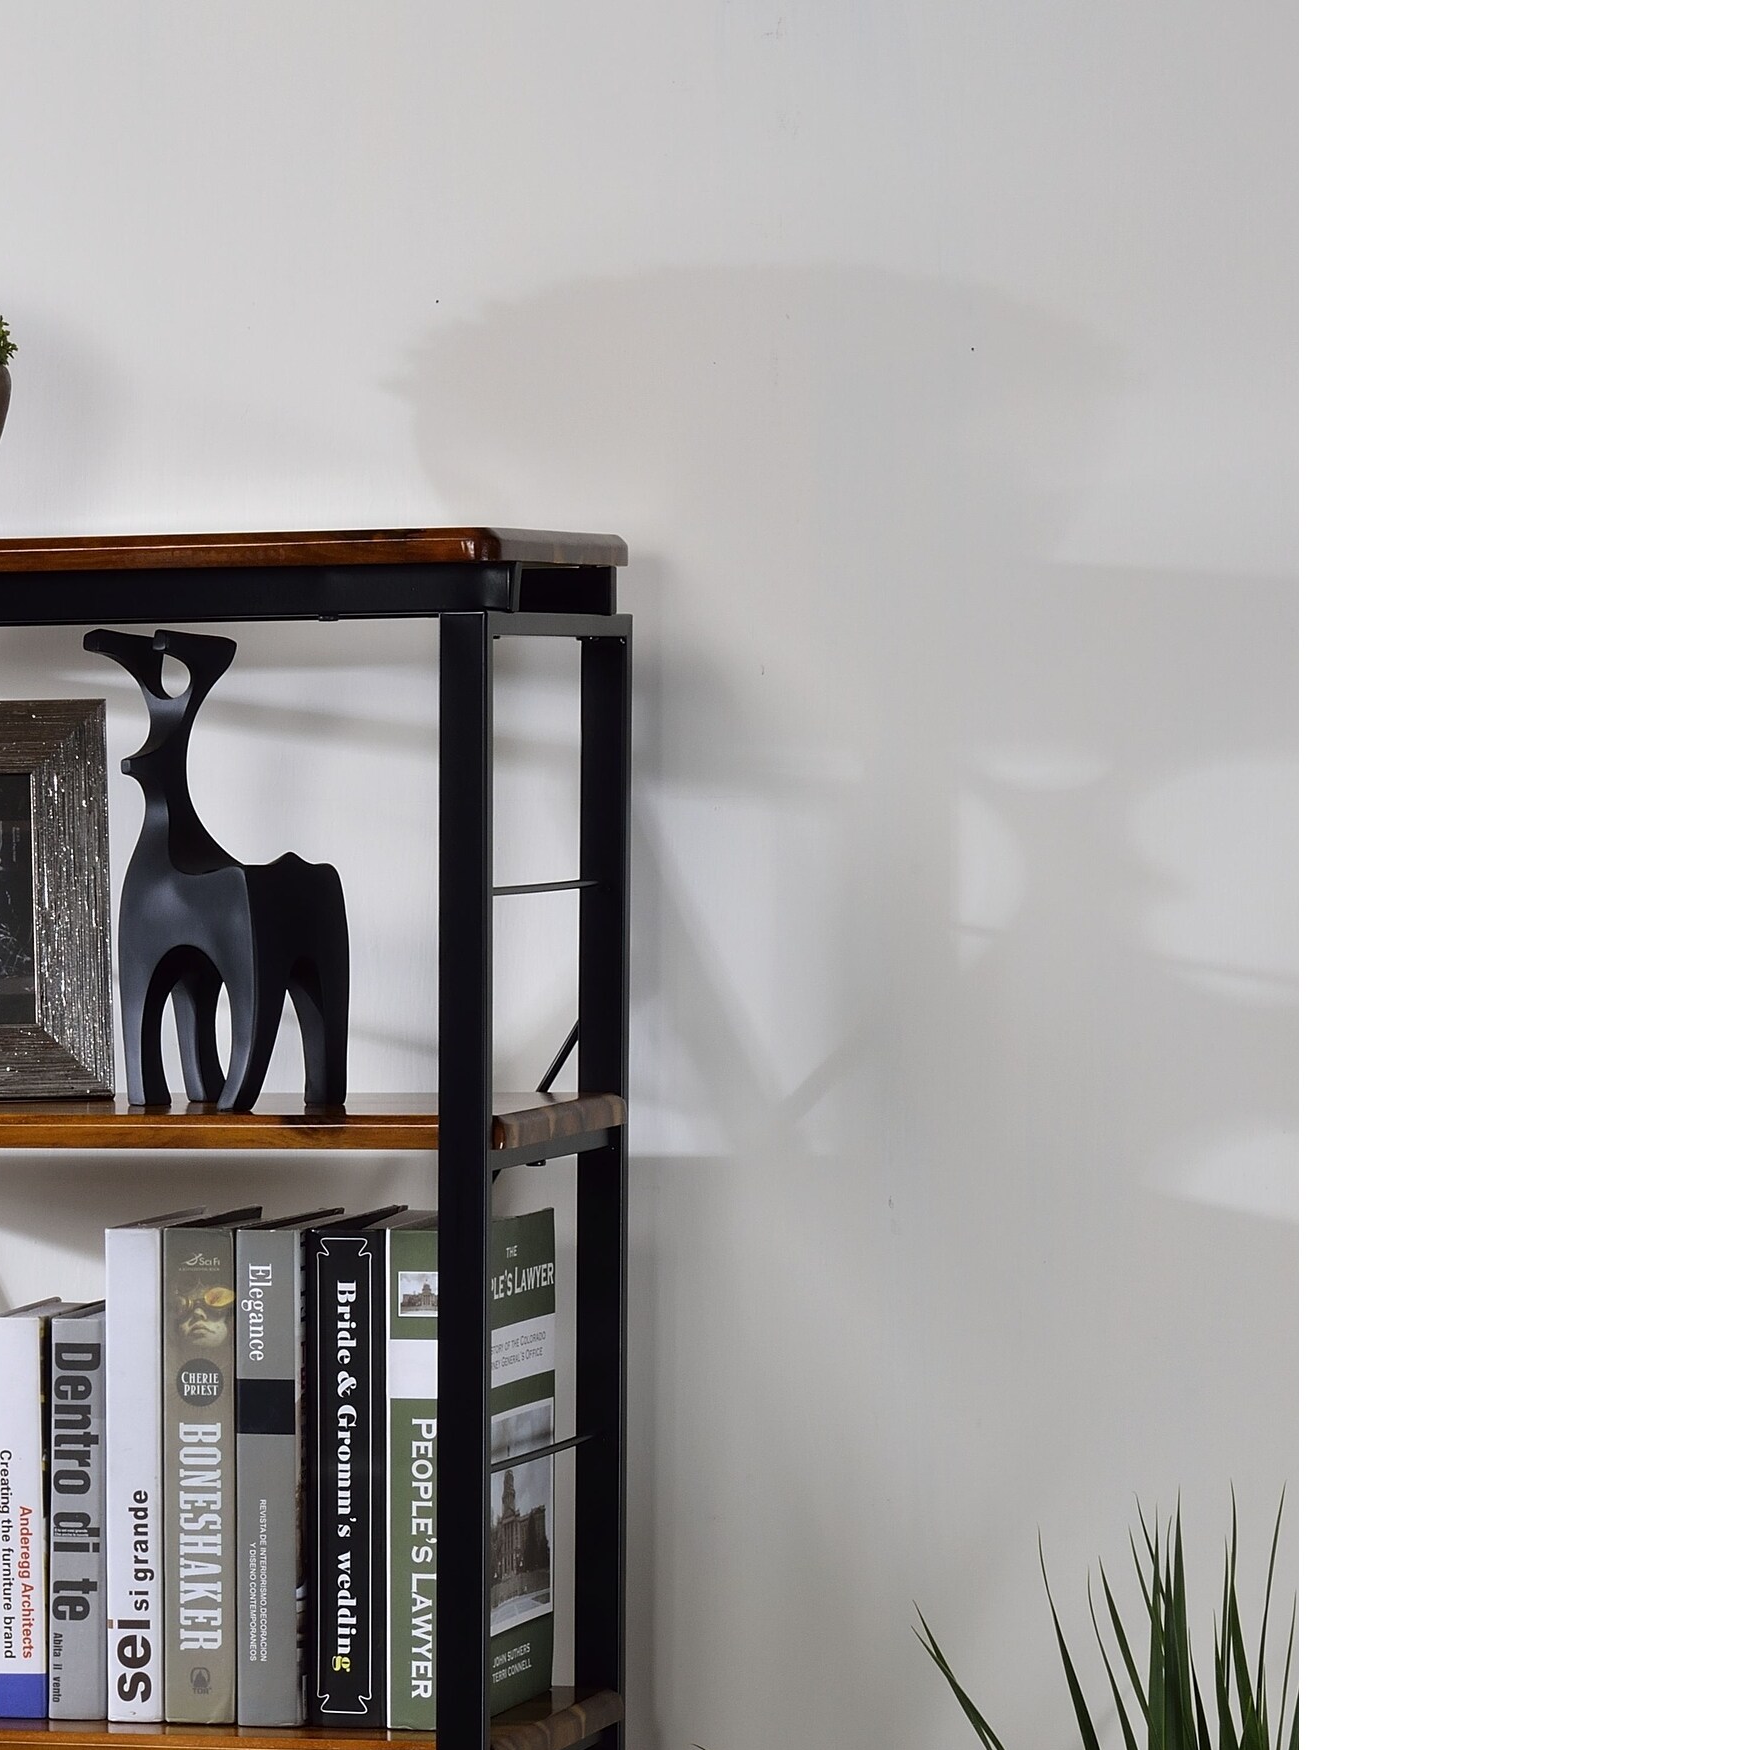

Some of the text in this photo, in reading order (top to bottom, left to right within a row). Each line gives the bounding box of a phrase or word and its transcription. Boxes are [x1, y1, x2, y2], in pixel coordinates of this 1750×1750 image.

[506, 1245, 518, 1259] THE
[514, 1262, 554, 1294] LAWYER
[241, 1263, 272, 1361] Elegance
[181, 1371, 219, 1384] CHERIE
[183, 1384, 219, 1396] PRIEST
[53, 1342, 101, 1495] Dentro
[331, 1280, 357, 1672] Bride & Gromm's wedding
[0, 1518, 12, 1542] the
[53, 1511, 100, 1553] di
[259, 1499, 267, 1533] REVISTA
[128, 1490, 155, 1582] grande
[179, 1422, 222, 1650] BONESHAKER
[259, 1535, 267, 1546] DE
[411, 1418, 437, 1699] PEOPLE'S LAWYER
[1, 1548, 14, 1611] furniture
[18, 1506, 35, 1659] Anderegg Architects
[52, 1578, 98, 1621] te
[129, 1591, 149, 1611] si
[3, 1616, 16, 1659] brand
[53, 1632, 63, 1658] Abita
[493, 1642, 530, 1668] JOHN SUTHERS
[507, 1658, 532, 1677] CONNELL
[52, 1677, 62, 1703] vento
